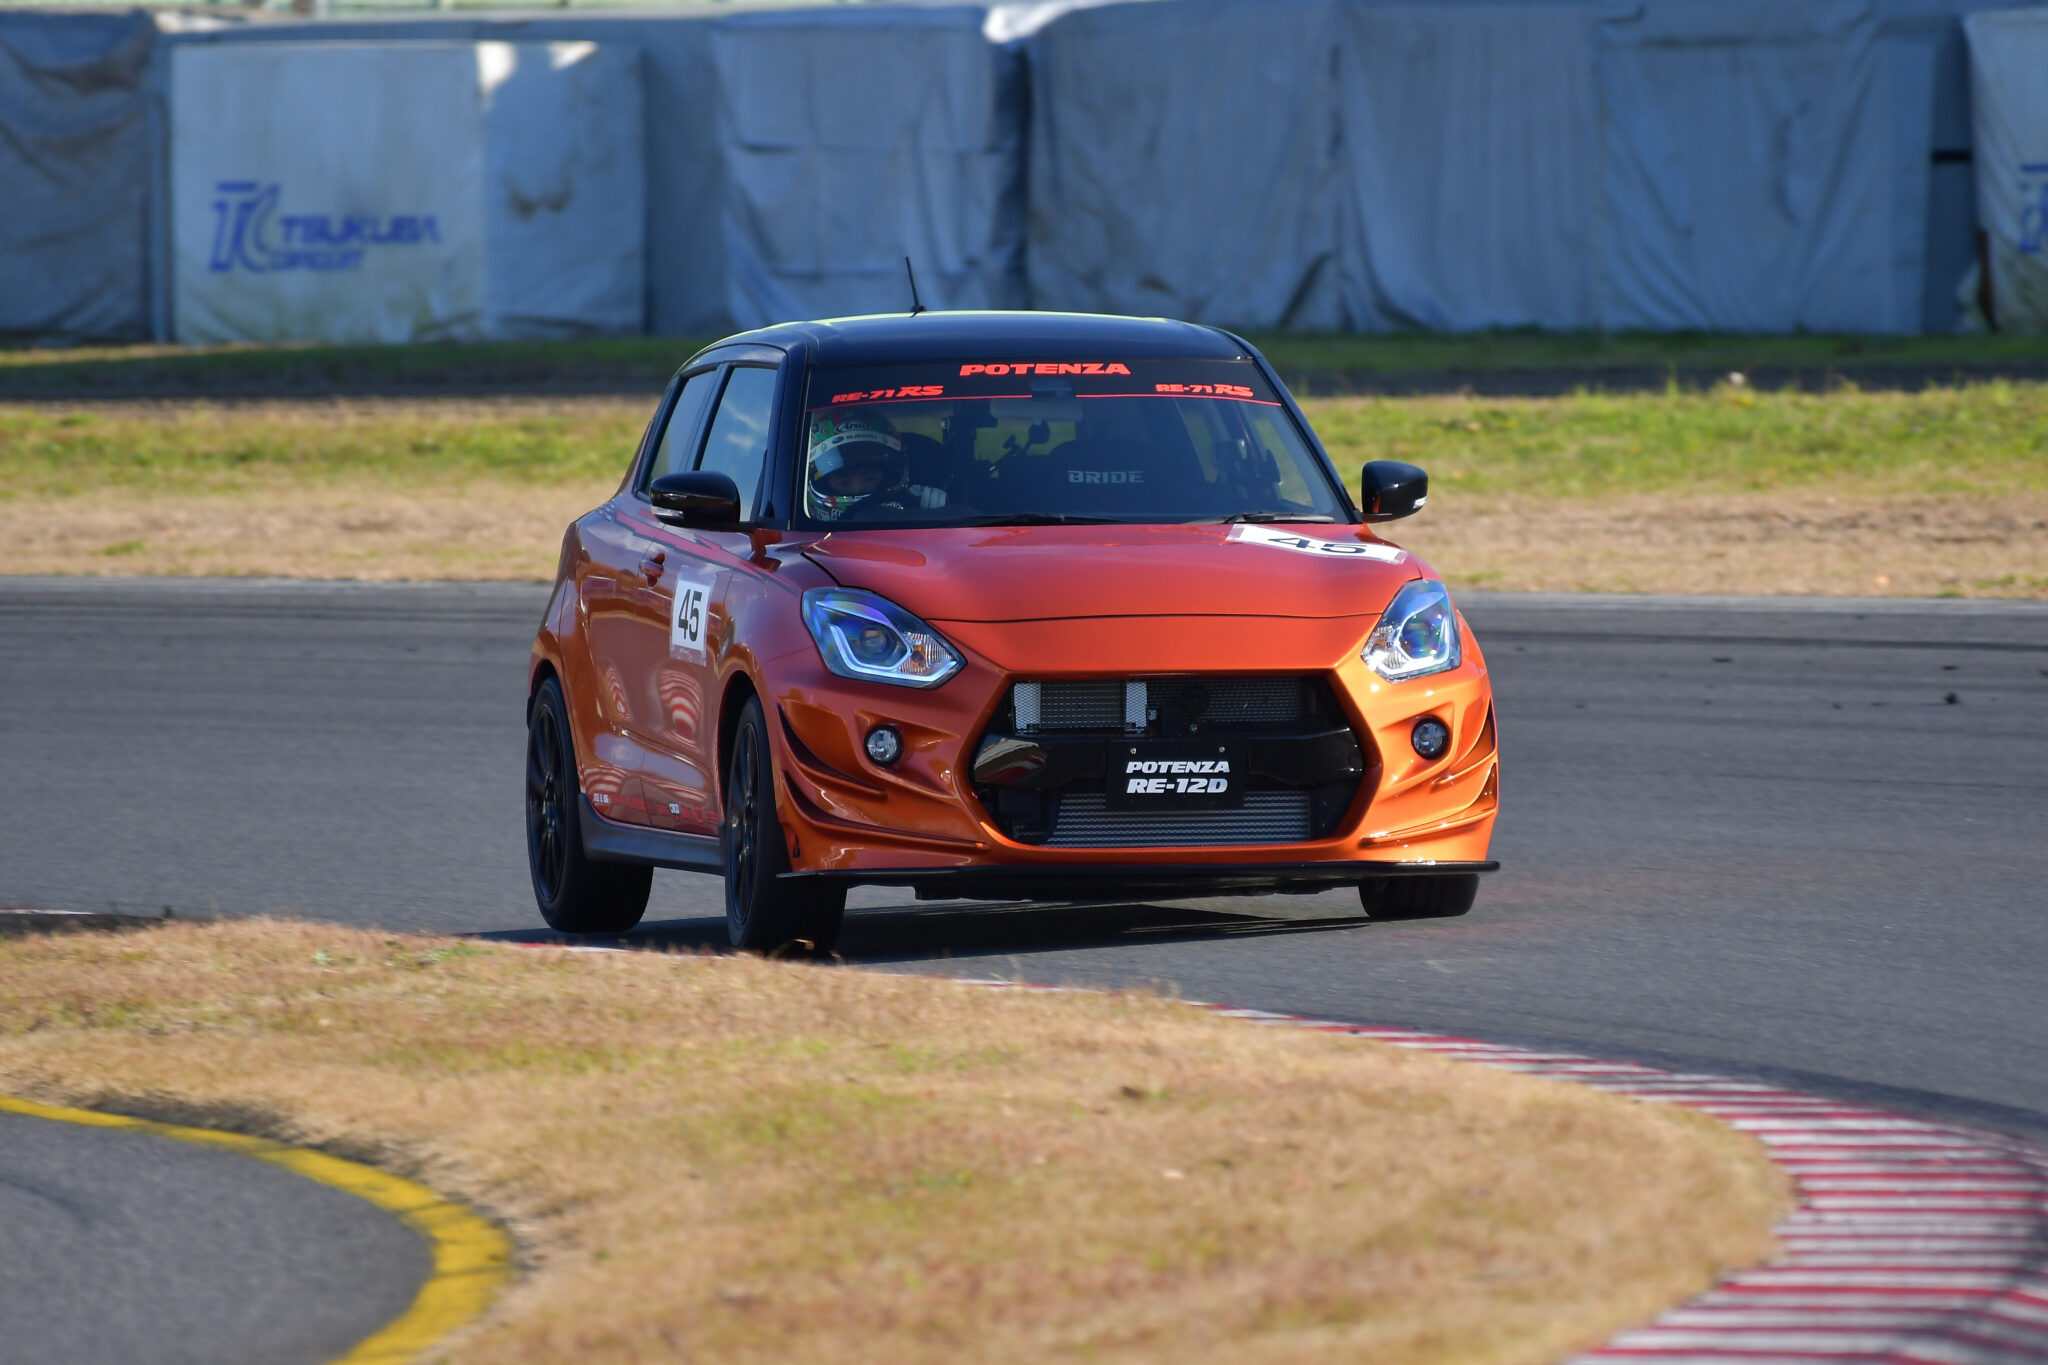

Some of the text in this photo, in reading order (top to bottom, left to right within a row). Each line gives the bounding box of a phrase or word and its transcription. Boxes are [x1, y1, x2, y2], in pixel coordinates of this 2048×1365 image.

[279, 214, 441, 244] TSUKUBA
[959, 363, 1132, 377] POTENZA
[1067, 470, 1144, 484] BRIDE
[1267, 537, 1367, 554] 45
[677, 588, 702, 642] 45
[1125, 760, 1230, 774] POTENZA
[1126, 778, 1228, 794] RE-12D
